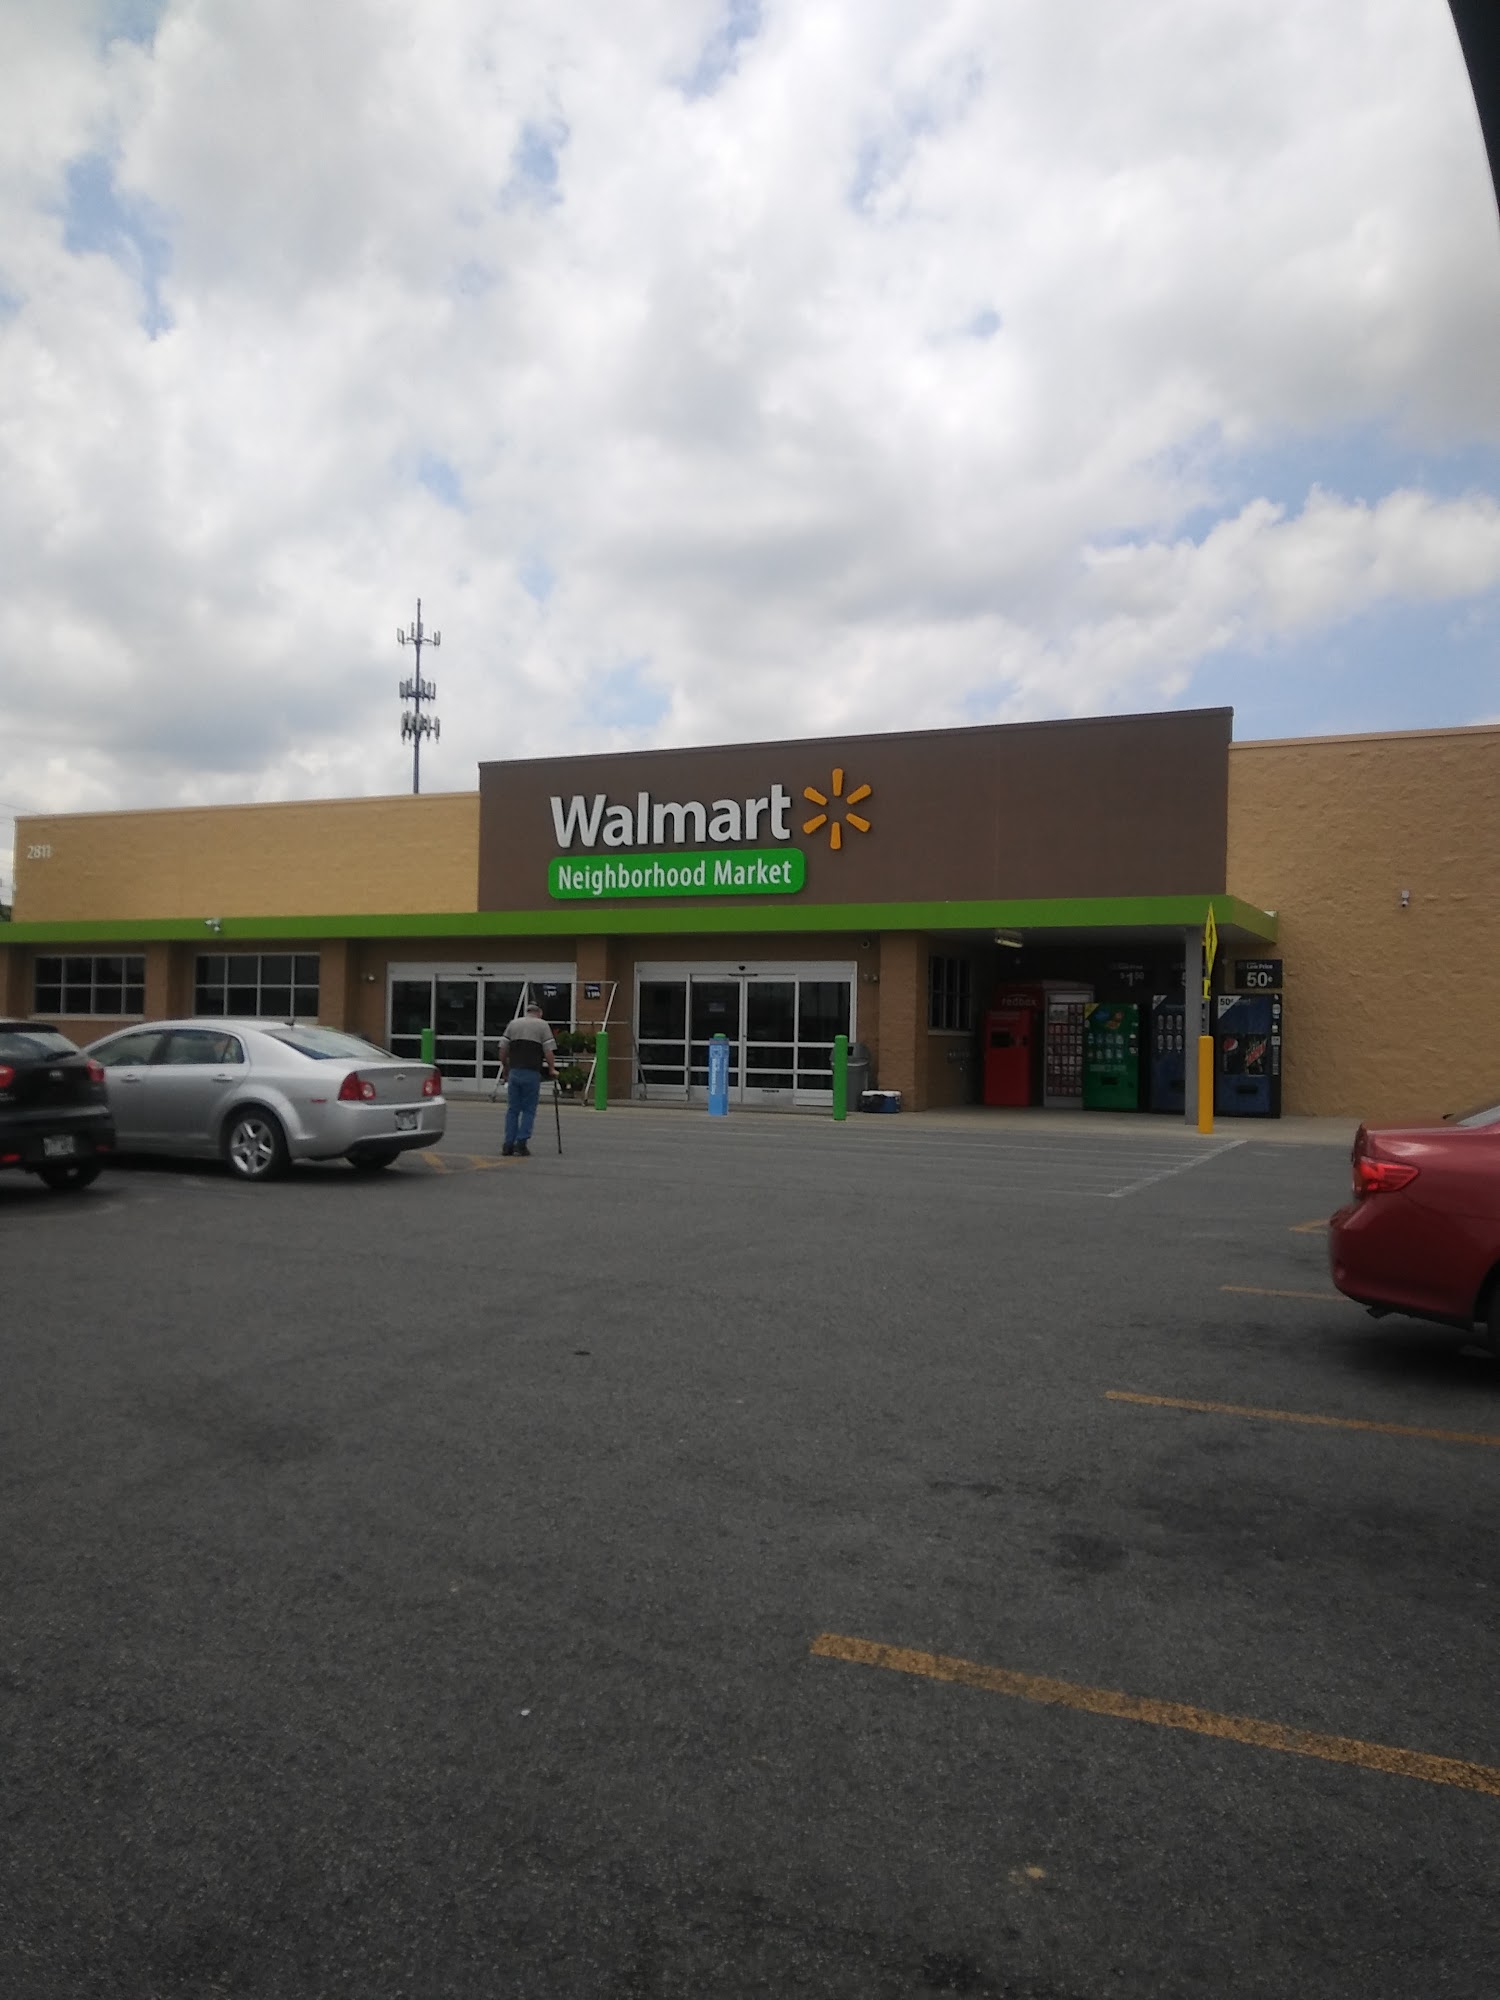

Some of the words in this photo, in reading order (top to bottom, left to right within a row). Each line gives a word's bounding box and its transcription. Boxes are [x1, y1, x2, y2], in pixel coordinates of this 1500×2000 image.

[550, 784, 791, 848] Walmart
[558, 861, 706, 895] Neighborhood
[713, 858, 792, 886] Market
[1001, 996, 1039, 1007] redbox
